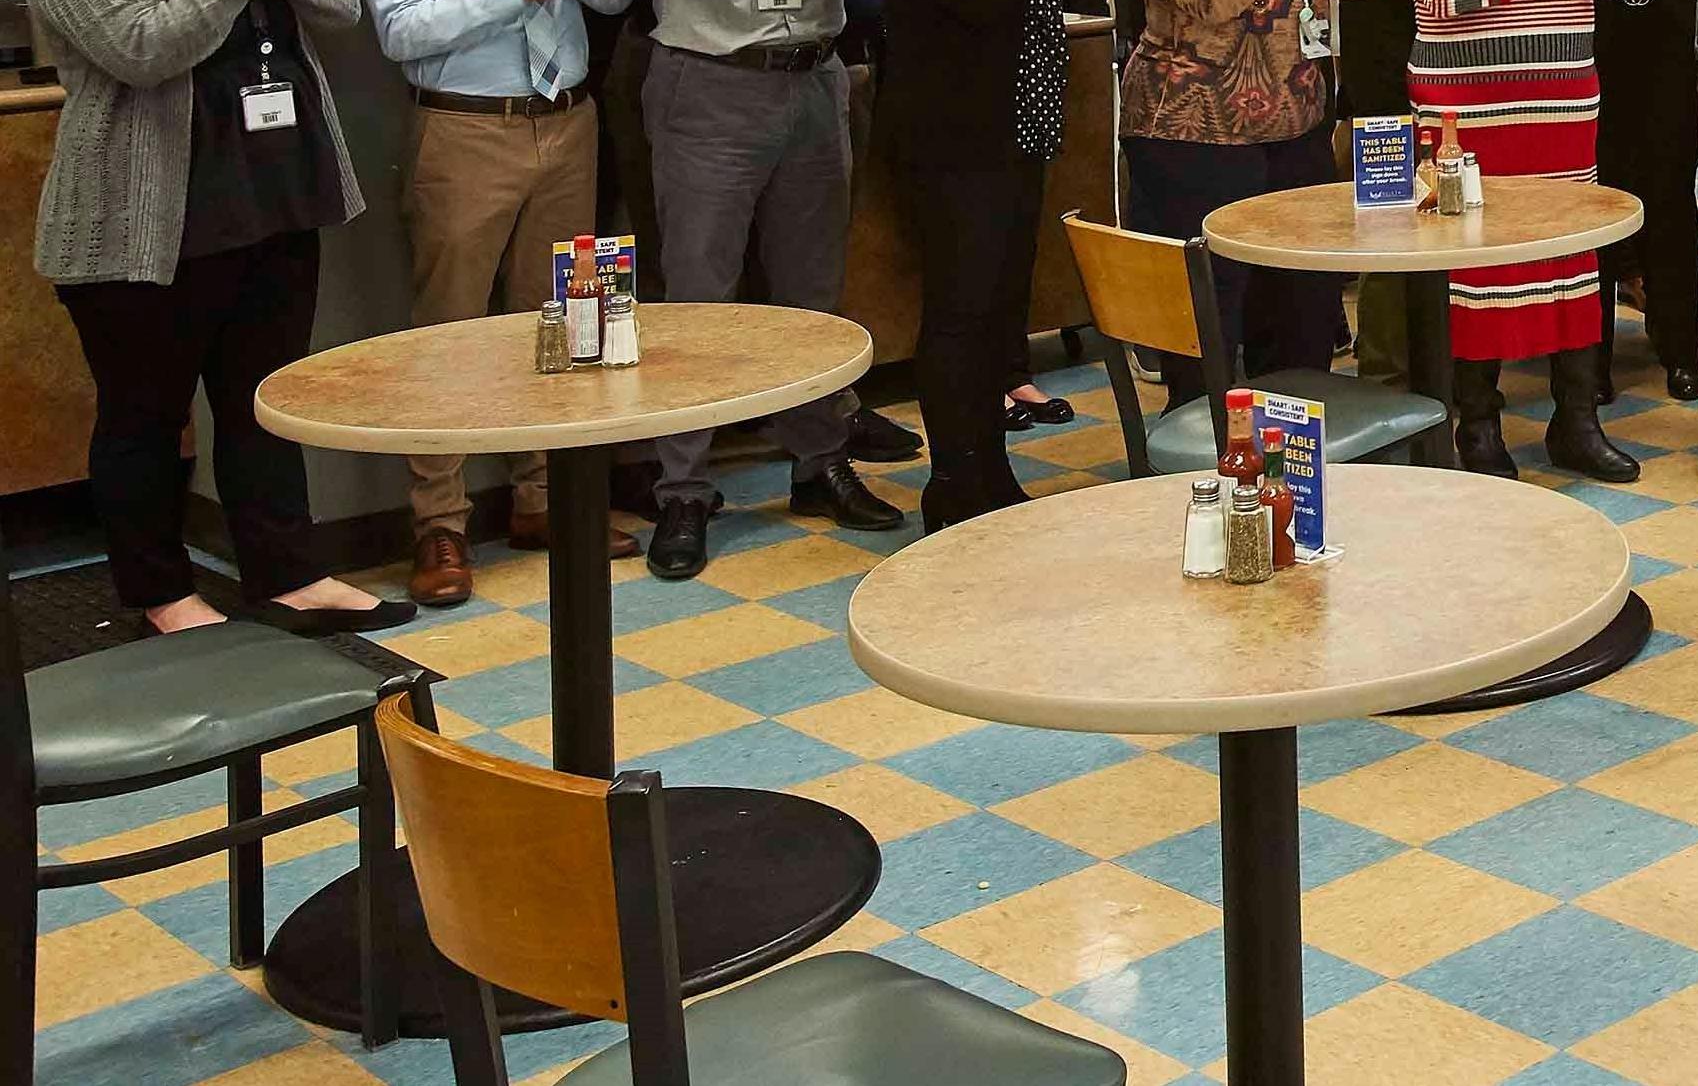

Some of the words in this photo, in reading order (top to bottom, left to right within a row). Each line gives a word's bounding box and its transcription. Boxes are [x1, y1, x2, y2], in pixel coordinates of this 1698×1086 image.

[1380, 137, 1407, 145] TABLE
[1363, 146, 1381, 154] HAS
[1283, 433, 1316, 450] TABLE
[1285, 448, 1312, 463] BEEN
